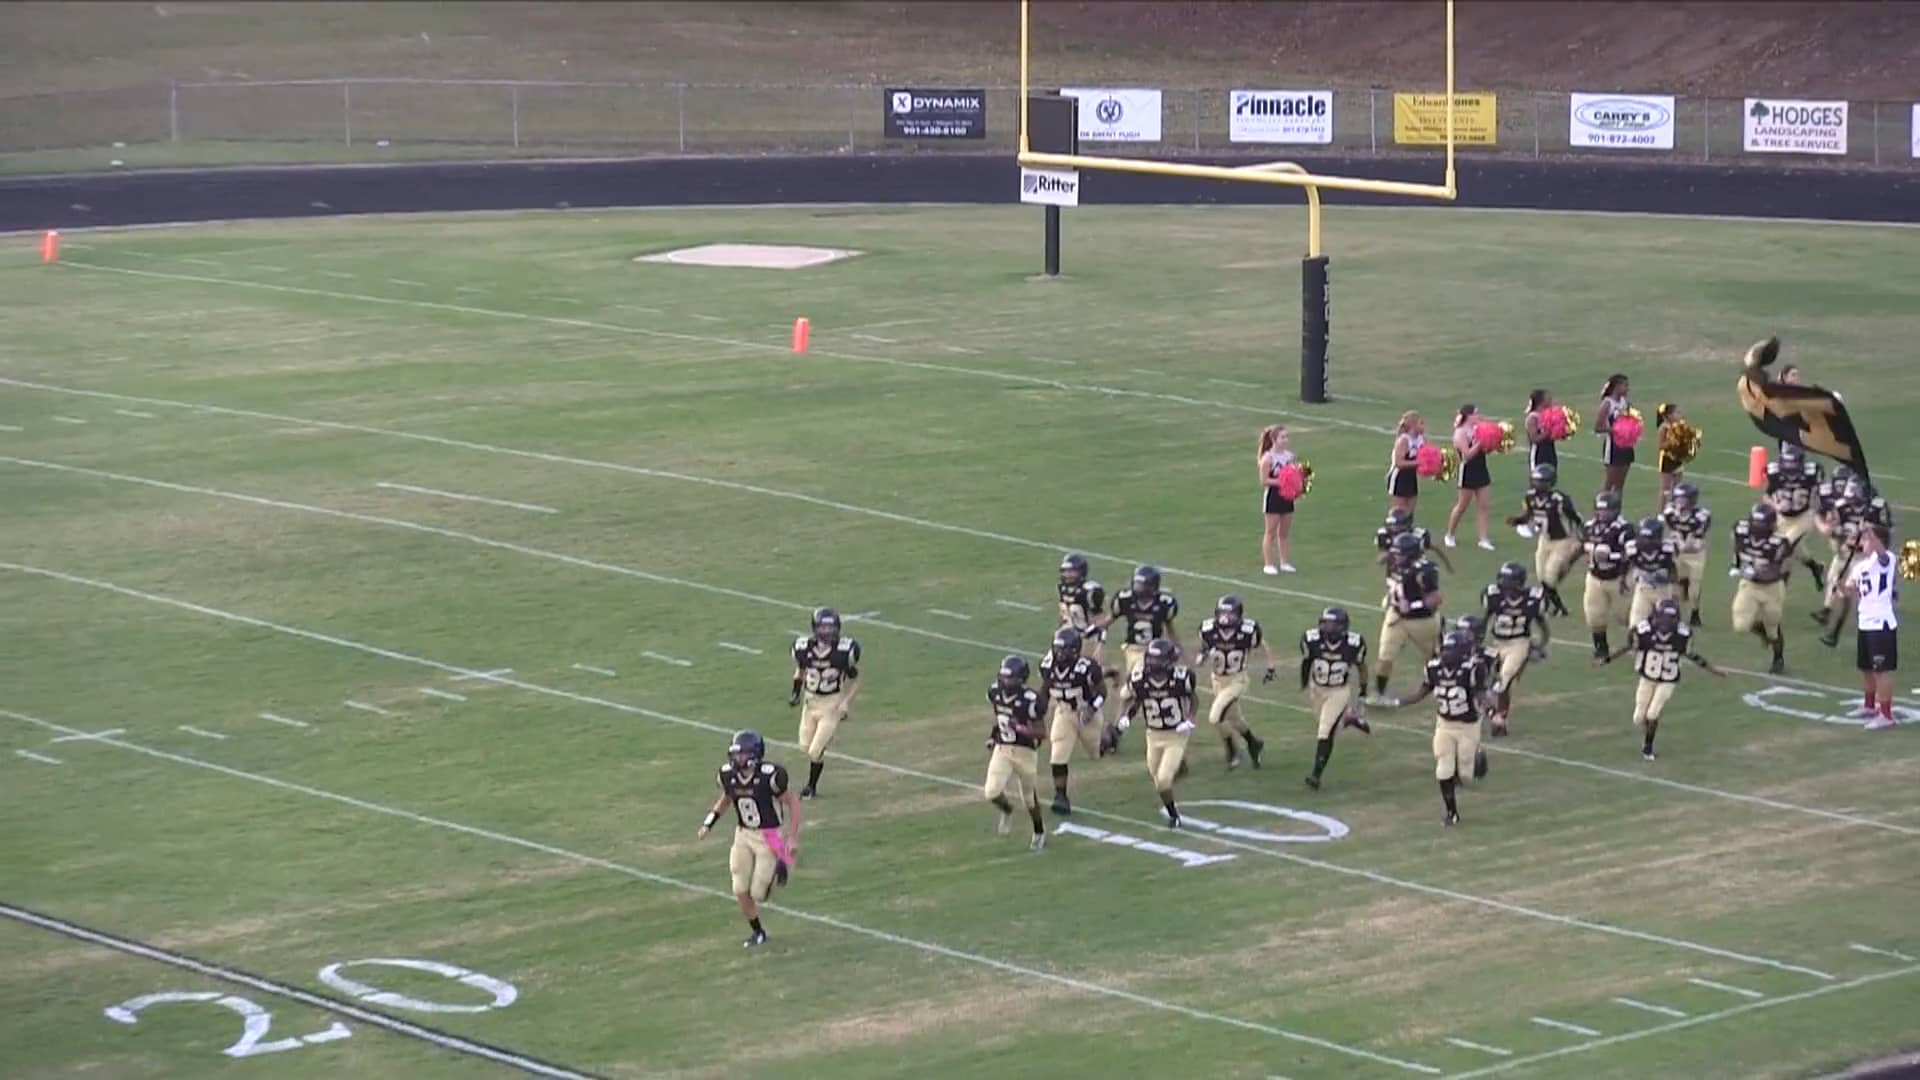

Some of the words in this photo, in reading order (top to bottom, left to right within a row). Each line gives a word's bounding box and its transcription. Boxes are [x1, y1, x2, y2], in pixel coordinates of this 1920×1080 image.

[913, 97, 980, 109] DYNAMIX
[1237, 94, 1326, 116] Pinnacle
[1772, 106, 1843, 127] HODGES
[1754, 127, 1837, 138] LANDSCAPING
[1764, 138, 1791, 148] TREE
[1794, 140, 1841, 150] SERVICE
[1038, 175, 1077, 193] Ritter
[1133, 620, 1153, 643] 3
[1643, 650, 1680, 680] 85
[1143, 697, 1183, 728] 23
[737, 797, 762, 828] 8
[1053, 800, 1350, 867] 10
[105, 958, 518, 1058] 20
